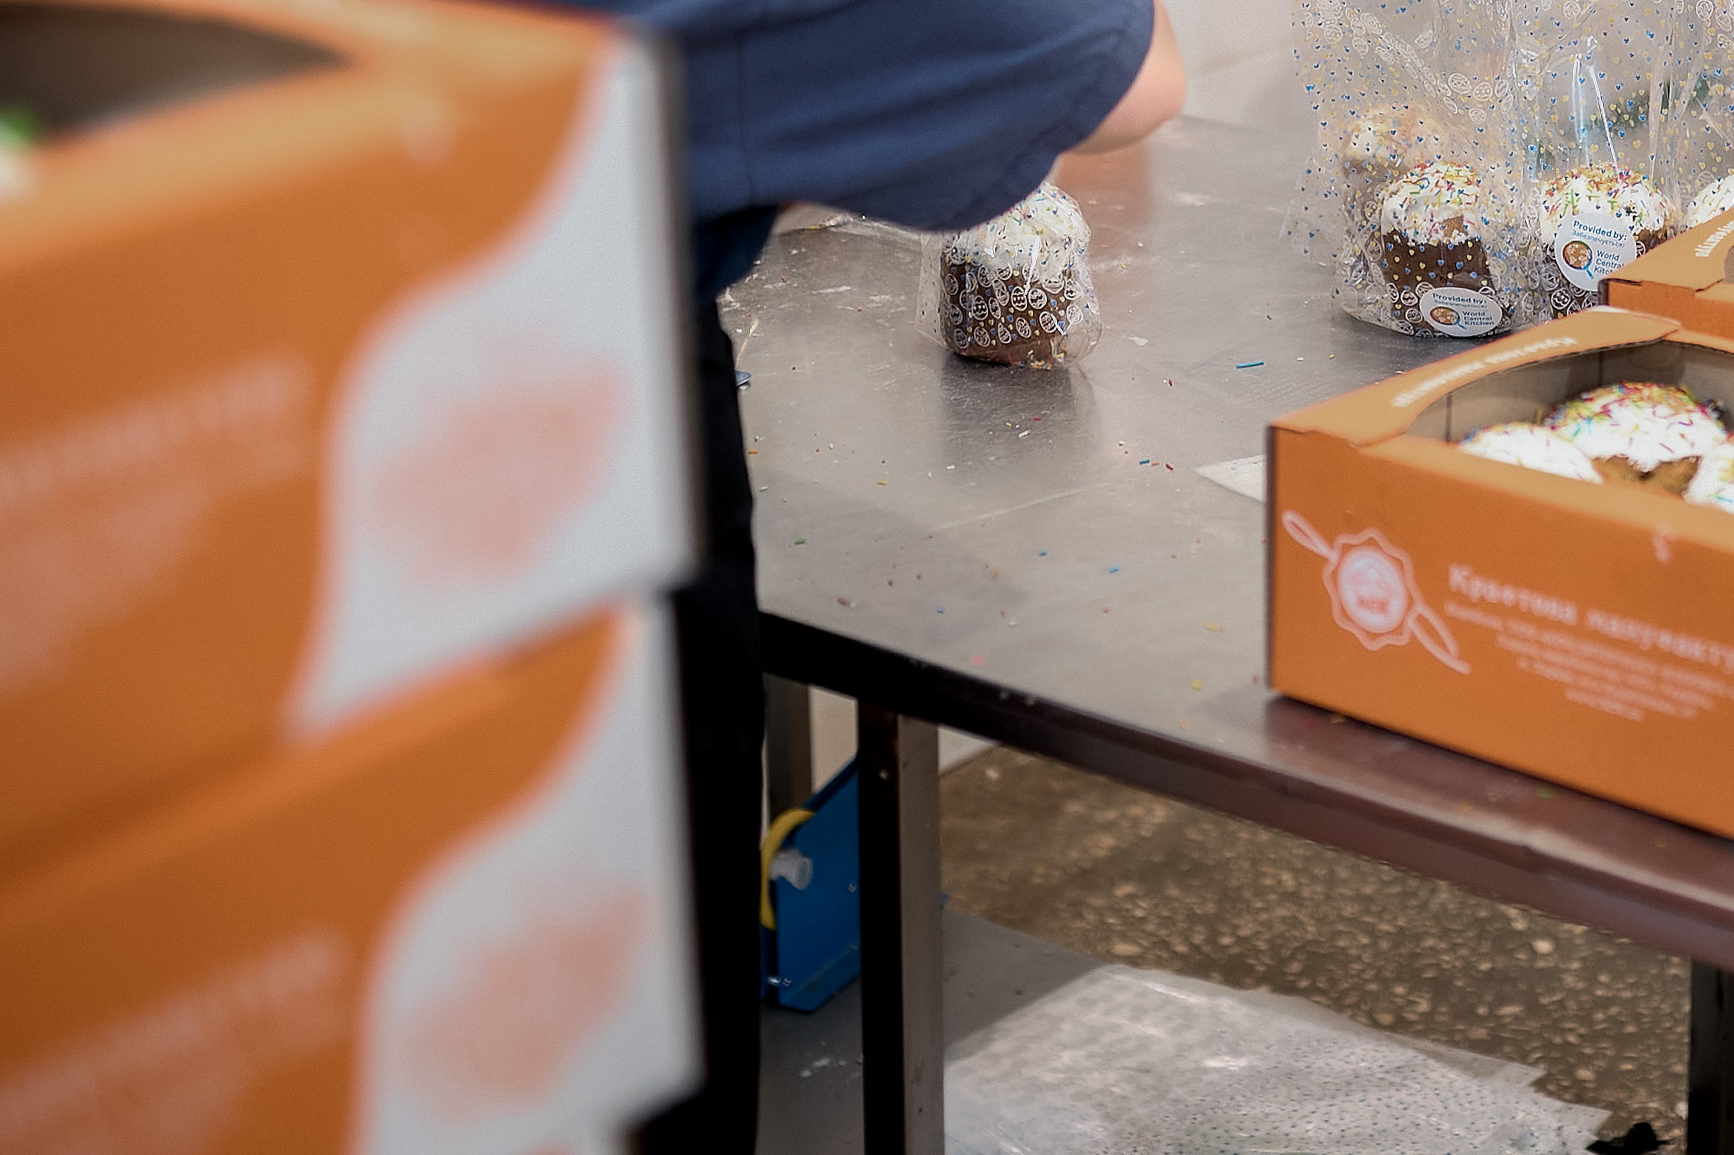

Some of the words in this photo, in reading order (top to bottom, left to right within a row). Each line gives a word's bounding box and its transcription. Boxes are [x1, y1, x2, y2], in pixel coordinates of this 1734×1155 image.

[1573, 220, 1612, 238] Provided
[1613, 230, 1628, 242] by:
[1596, 249, 1620, 262] World
[1432, 292, 1471, 304] Provided
